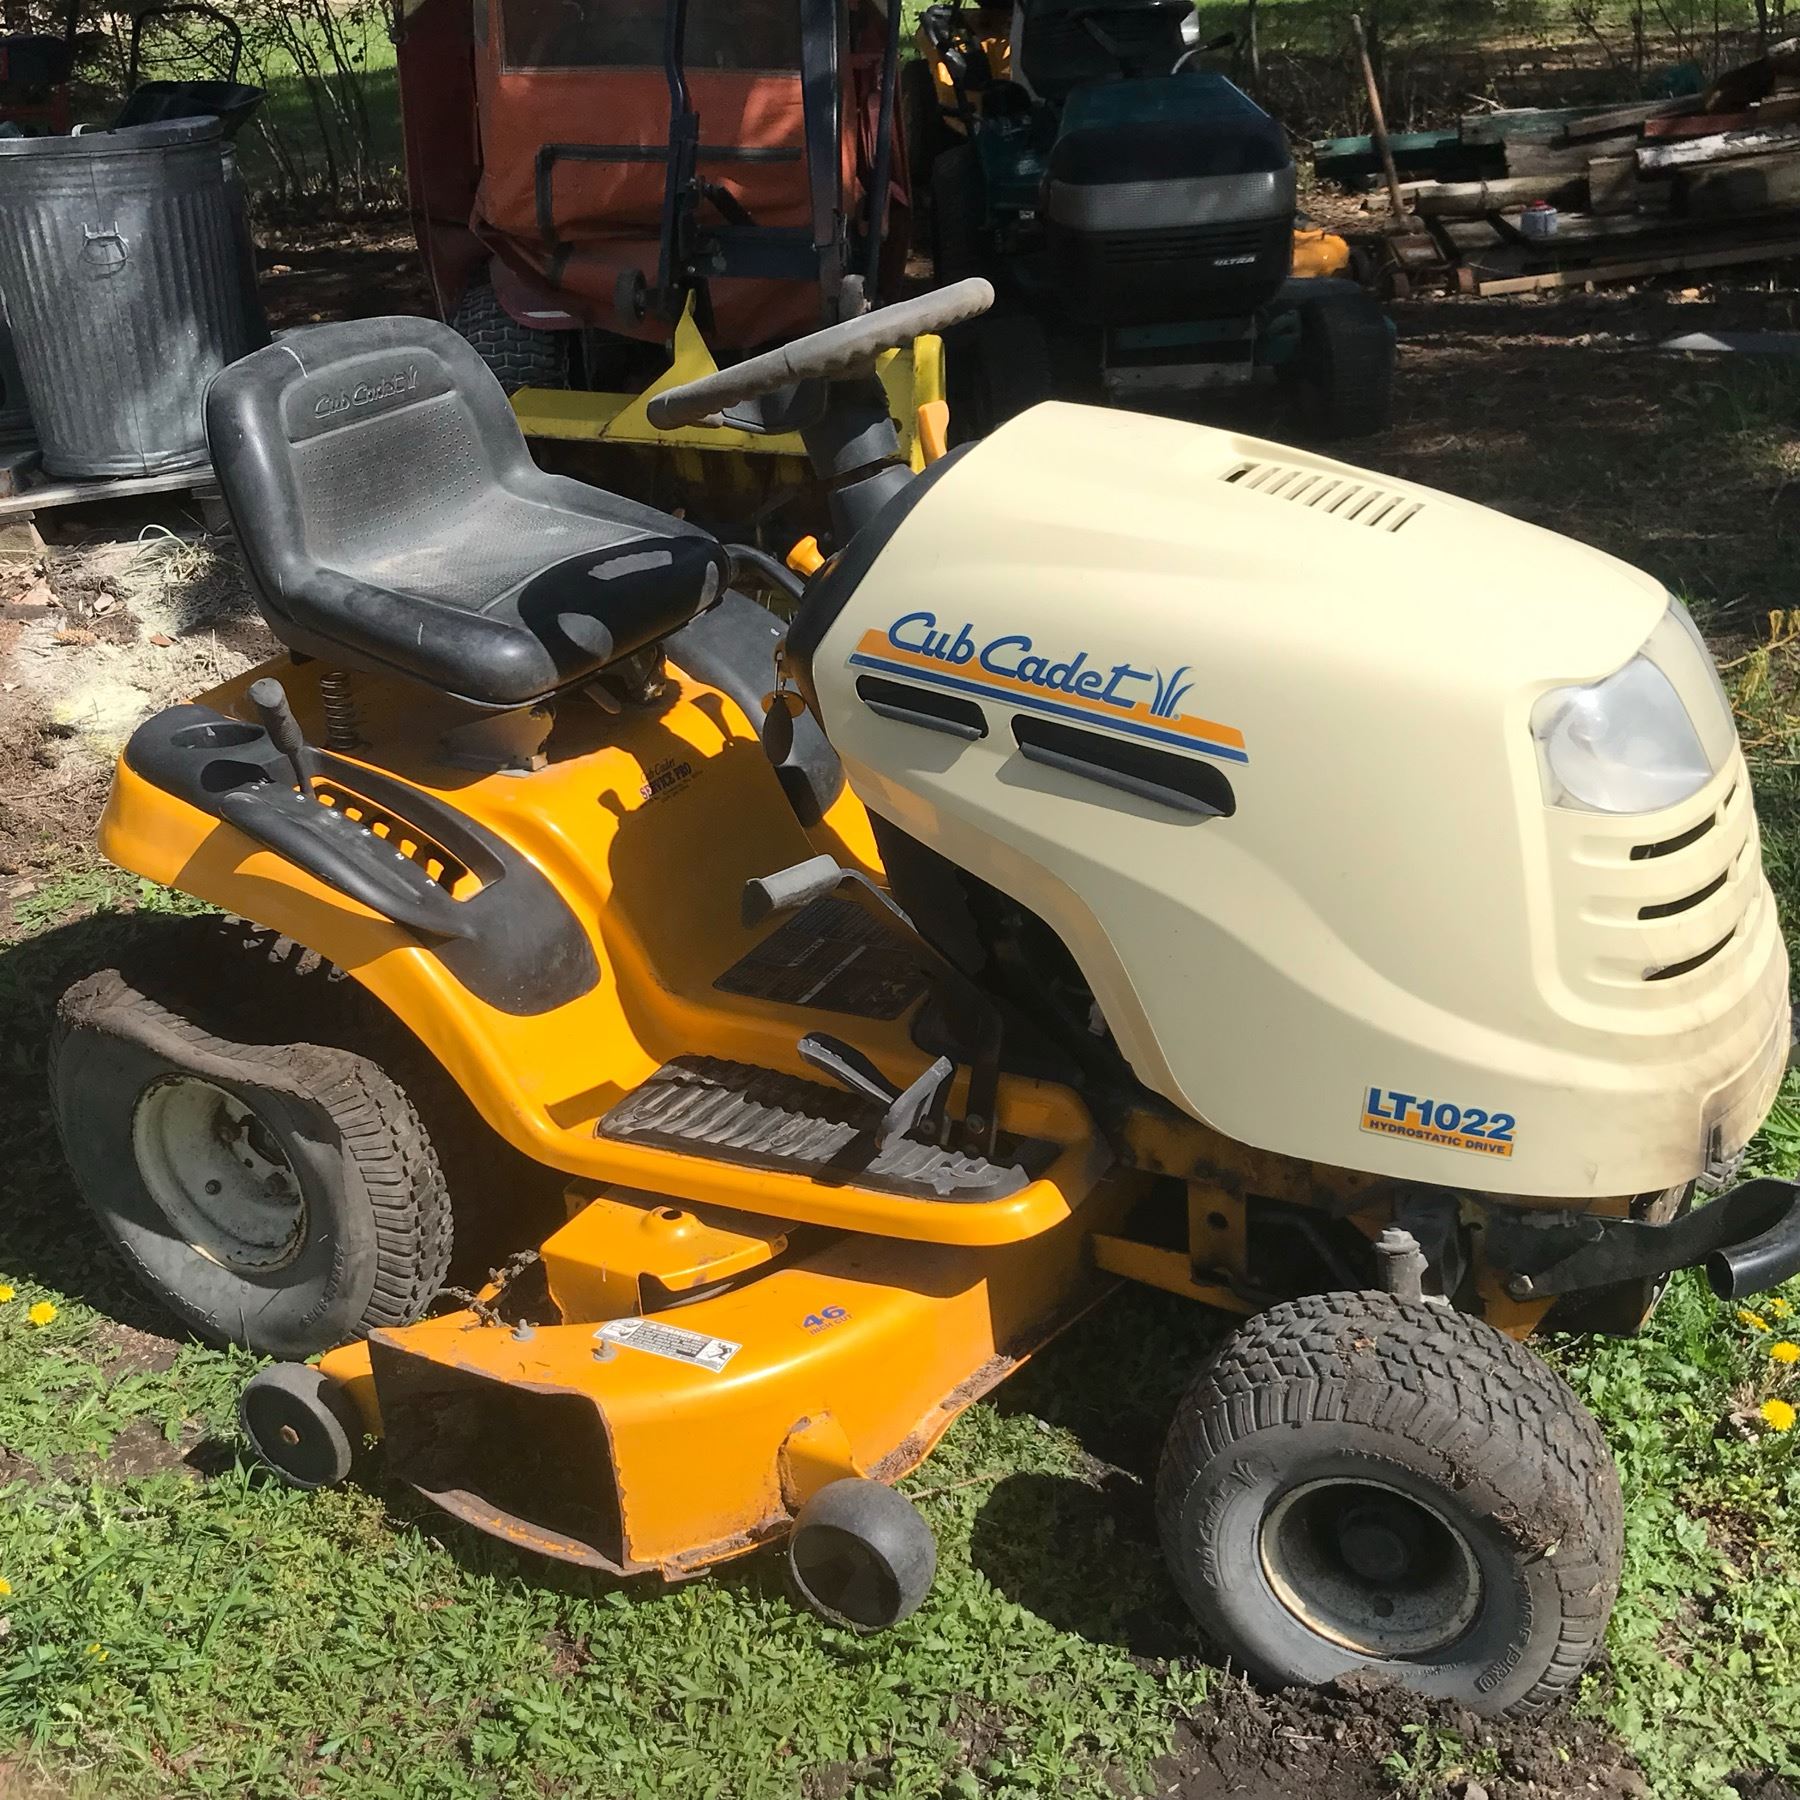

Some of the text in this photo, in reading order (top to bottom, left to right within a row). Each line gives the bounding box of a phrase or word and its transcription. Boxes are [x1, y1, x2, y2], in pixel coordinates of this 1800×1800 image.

[315, 390, 350, 419] Cub
[887, 611, 1154, 709] Cub Cadet
[1368, 1087, 1515, 1141] LT1022
[1369, 1119, 1506, 1154] HYDROSTATIC DRIVE
[803, 1304, 846, 1328] 46
[834, 1313, 853, 1325] CUT
